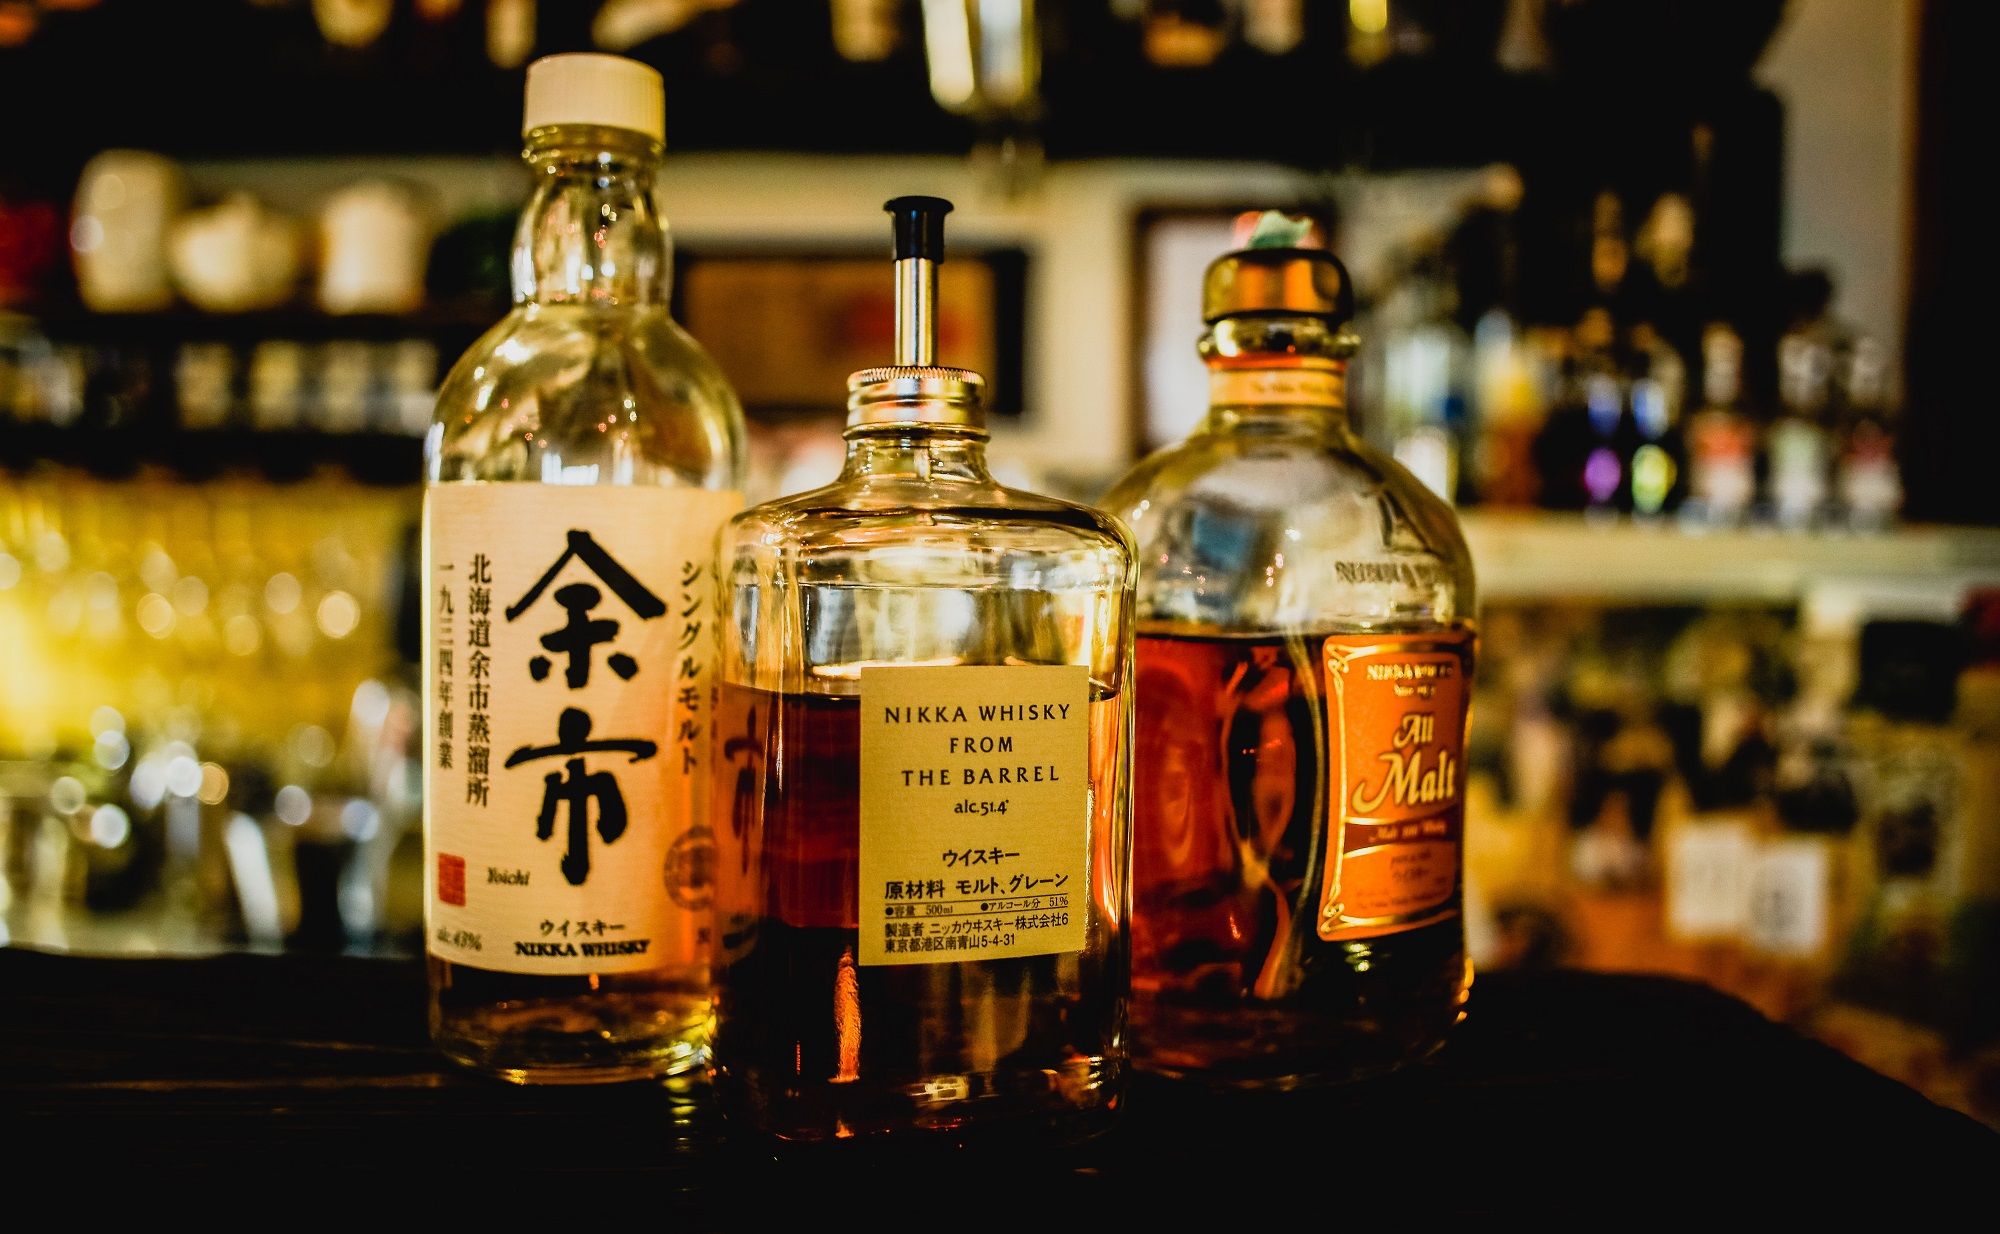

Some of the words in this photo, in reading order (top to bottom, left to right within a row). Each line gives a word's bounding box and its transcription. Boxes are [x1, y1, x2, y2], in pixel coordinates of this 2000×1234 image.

[677, 560, 702, 776] シングルモルト
[504, 529, 668, 886] 余市
[885, 706, 968, 724] NIKKA
[978, 703, 1071, 721] WHISKY
[1393, 712, 1434, 750] All
[949, 736, 1014, 754] FROM
[901, 769, 951, 787] THE
[963, 765, 1060, 785] BARREL
[1351, 750, 1457, 815] Malt
[942, 847, 1020, 867] ウイスキー
[884, 879, 946, 900] 原材料
[540, 919, 626, 937] ウイスキー
[514, 941, 579, 957] NIKKA
[580, 939, 652, 957] WHISKY
